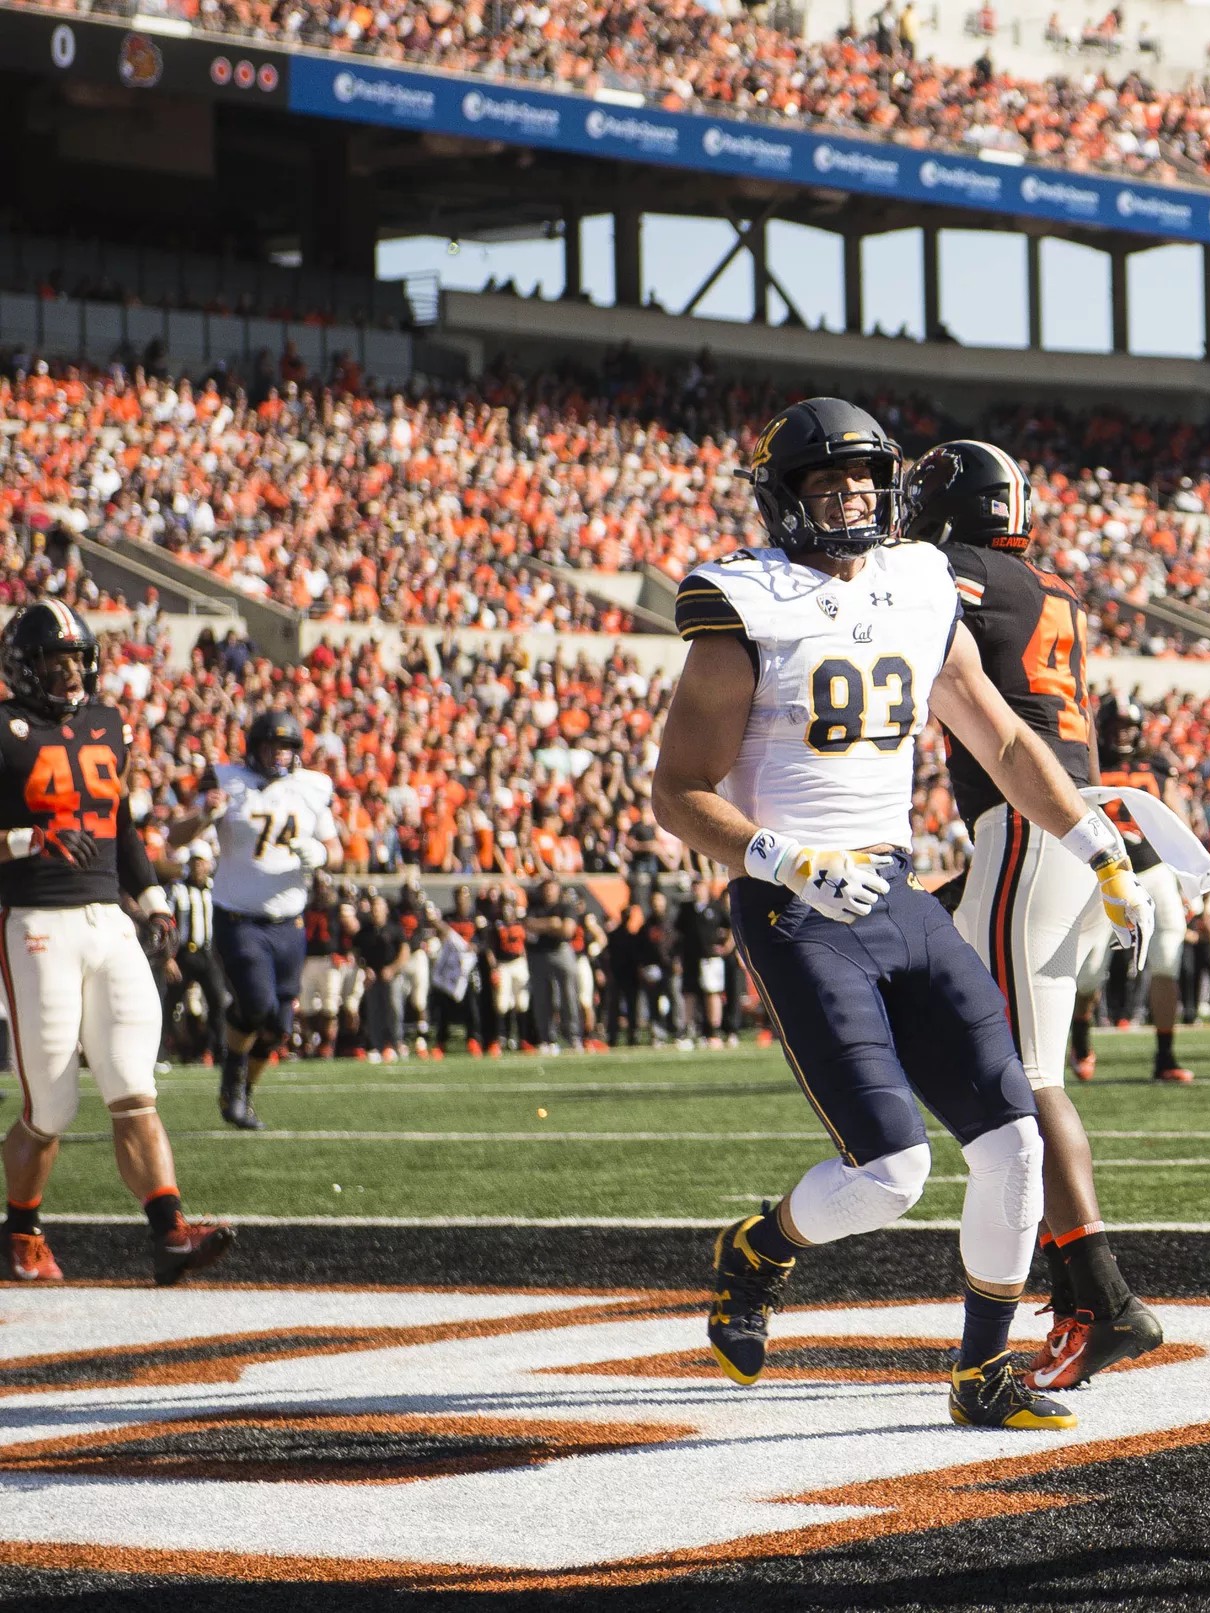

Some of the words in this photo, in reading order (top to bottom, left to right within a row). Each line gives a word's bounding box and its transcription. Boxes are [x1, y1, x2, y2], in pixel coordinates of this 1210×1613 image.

[52, 24, 76, 69] 0
[852, 623, 873, 644] Cal
[1021, 594, 1090, 744] 4
[806, 655, 917, 756] 83
[24, 744, 121, 839] 49
[250, 811, 300, 861] 74
